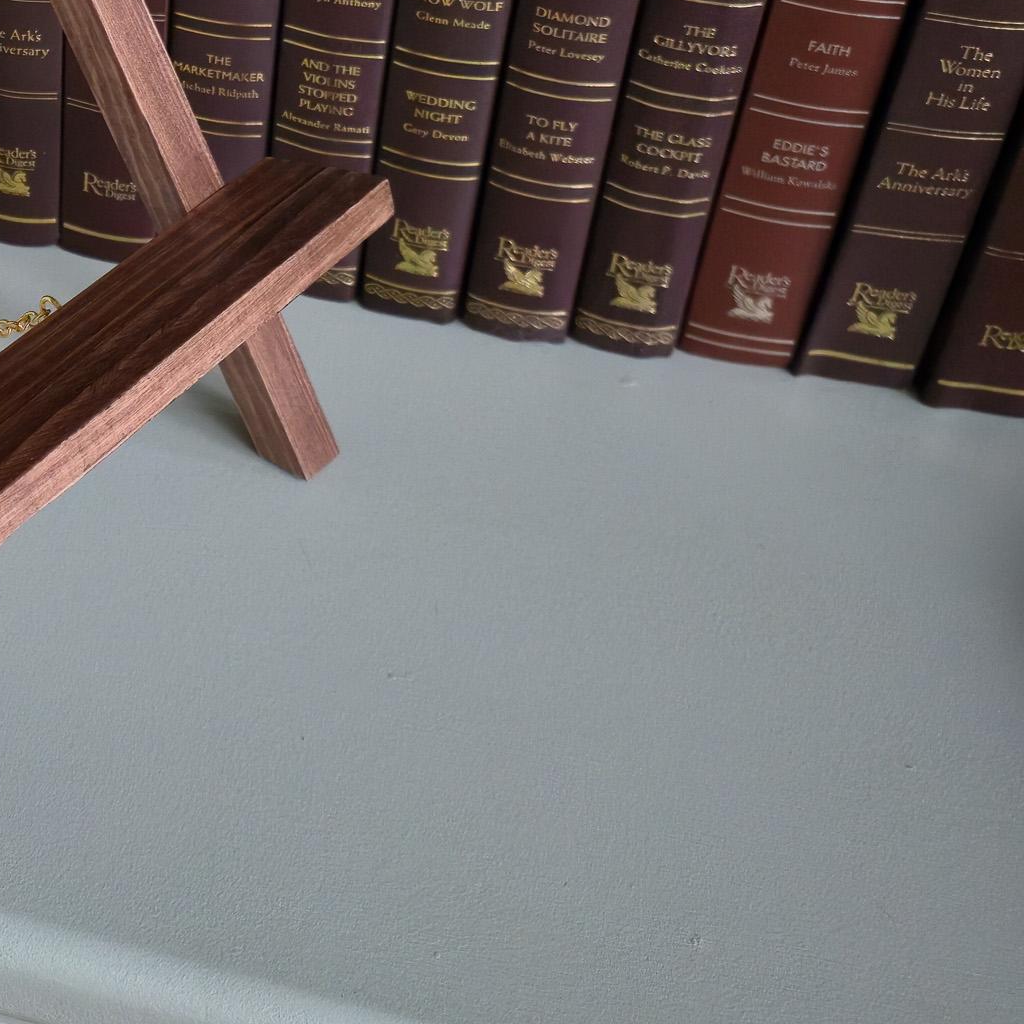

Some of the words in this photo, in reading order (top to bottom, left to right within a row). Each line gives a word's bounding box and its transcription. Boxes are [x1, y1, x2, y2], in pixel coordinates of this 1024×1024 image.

[416, 10, 449, 26] Glenn
[452, 17, 491, 30] Meade
[535, 6, 612, 28] DIAMOND
[10, 30, 41, 42] Ark's
[532, 22, 609, 44] SOLITAIRE
[682, 24, 717, 40] THE
[528, 39, 556, 56] Peter
[559, 48, 606, 64] Lovesey
[808, 40, 852, 58] FAITH
[960, 45, 993, 63] The
[206, 54, 232, 67] THE
[301, 58, 330, 72] AND
[334, 63, 361, 78] THE
[939, 59, 1001, 81] Women
[820, 64, 859, 78] James
[298, 84, 358, 104] STOPPED
[956, 82, 975, 94] in
[298, 98, 354, 118] PLAYING
[405, 90, 478, 112] WEDDING
[925, 91, 956, 111] His
[958, 95, 992, 112] Life
[413, 107, 463, 125] NIGHT
[526, 114, 549, 128] TO
[552, 120, 578, 133] FLY
[526, 130, 536, 142] A
[539, 132, 572, 148] KITE
[634, 124, 664, 141] THE
[636, 142, 704, 164] COCKPIT
[772, 138, 830, 158] EDDIE'S
[761, 152, 827, 172] BASTARD
[896, 161, 928, 179] The
[82, 171, 136, 194] Reader's
[877, 176, 973, 199] Anniversary
